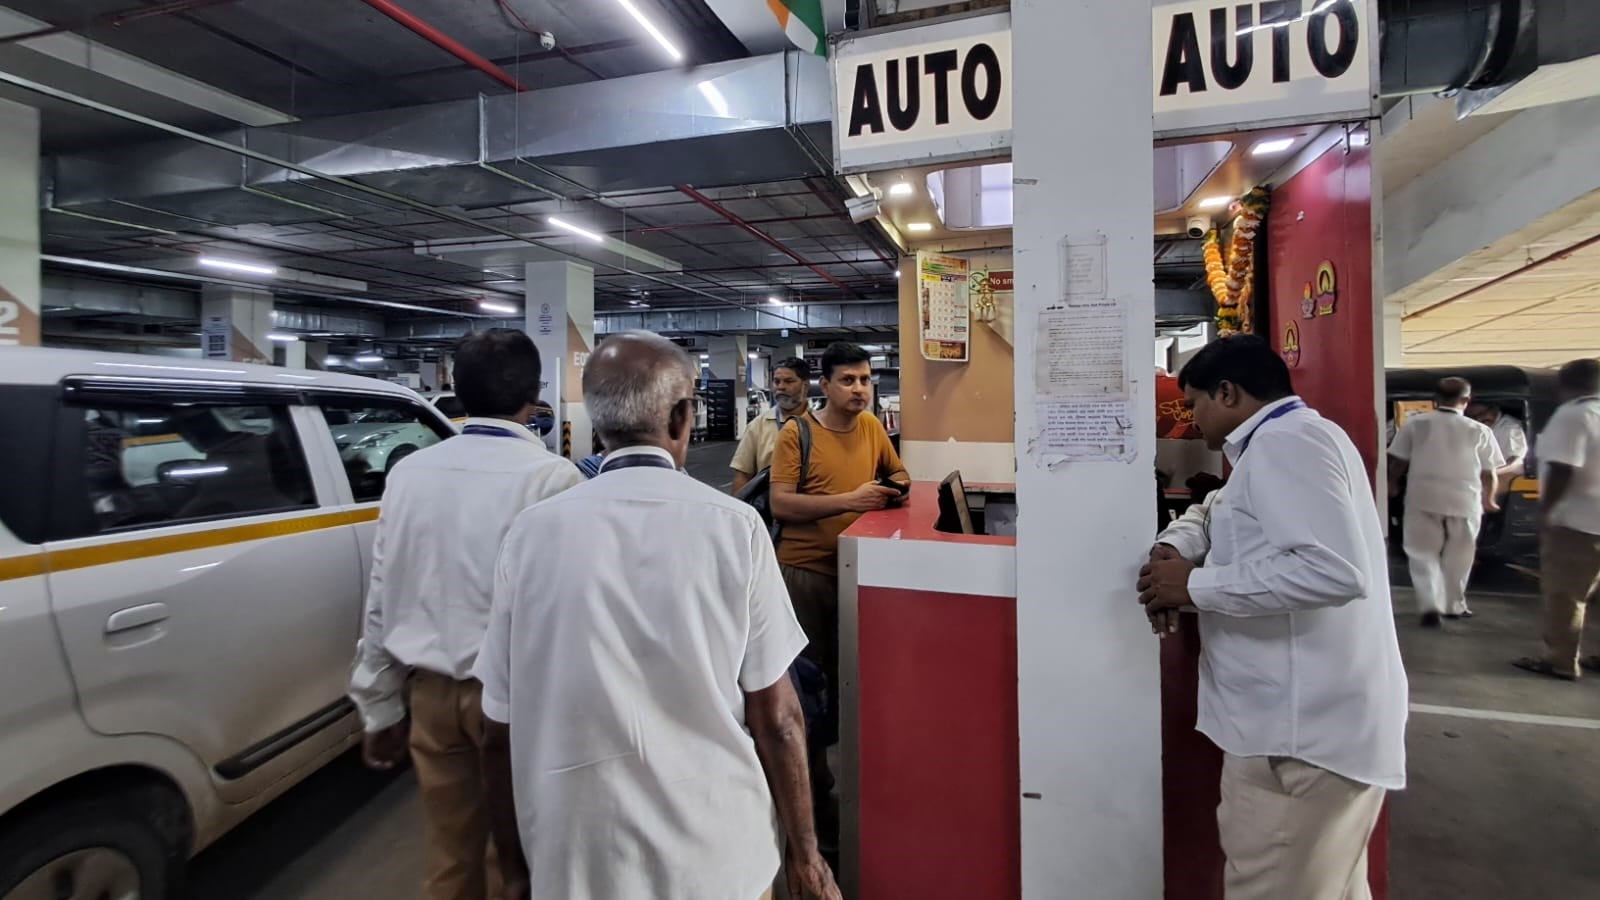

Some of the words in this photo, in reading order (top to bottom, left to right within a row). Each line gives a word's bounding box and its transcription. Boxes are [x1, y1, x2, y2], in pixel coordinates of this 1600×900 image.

[848, 43, 1002, 137] AUTO
[1160, 0, 1359, 96] AUTO
[990, 277, 1000, 285] No
